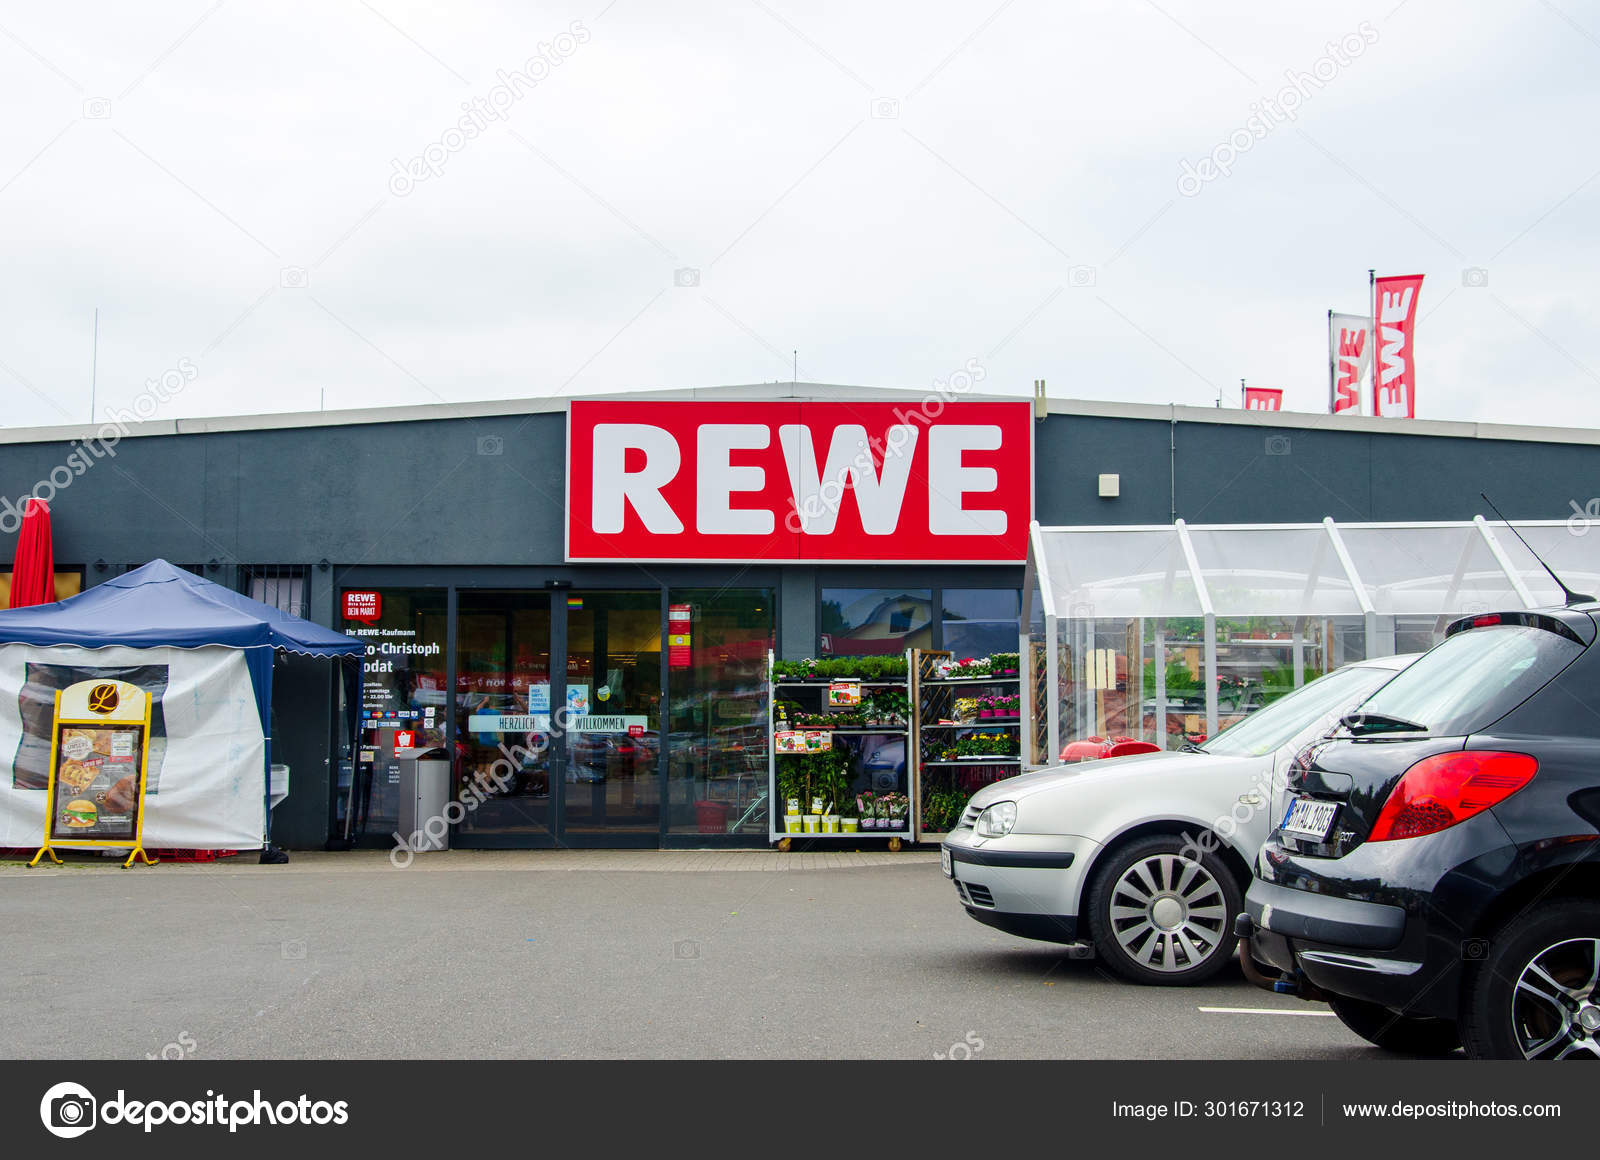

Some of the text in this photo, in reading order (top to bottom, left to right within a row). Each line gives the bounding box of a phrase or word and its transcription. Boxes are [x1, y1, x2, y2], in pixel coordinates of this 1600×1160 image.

[1379, 286, 1414, 418] EWE
[1333, 327, 1366, 416] WE
[591, 422, 1008, 536] REWE
[347, 593, 376, 602] REWE
[347, 607, 375, 616] DEIN MARKT
[345, 628, 416, 636] Ihr REWE-Kaufmann
[364, 642, 440, 657] o-Christoph
[363, 660, 393, 673] odat
[499, 717, 535, 730] HERZLICH
[575, 717, 625, 730] WILLKOMMEN
